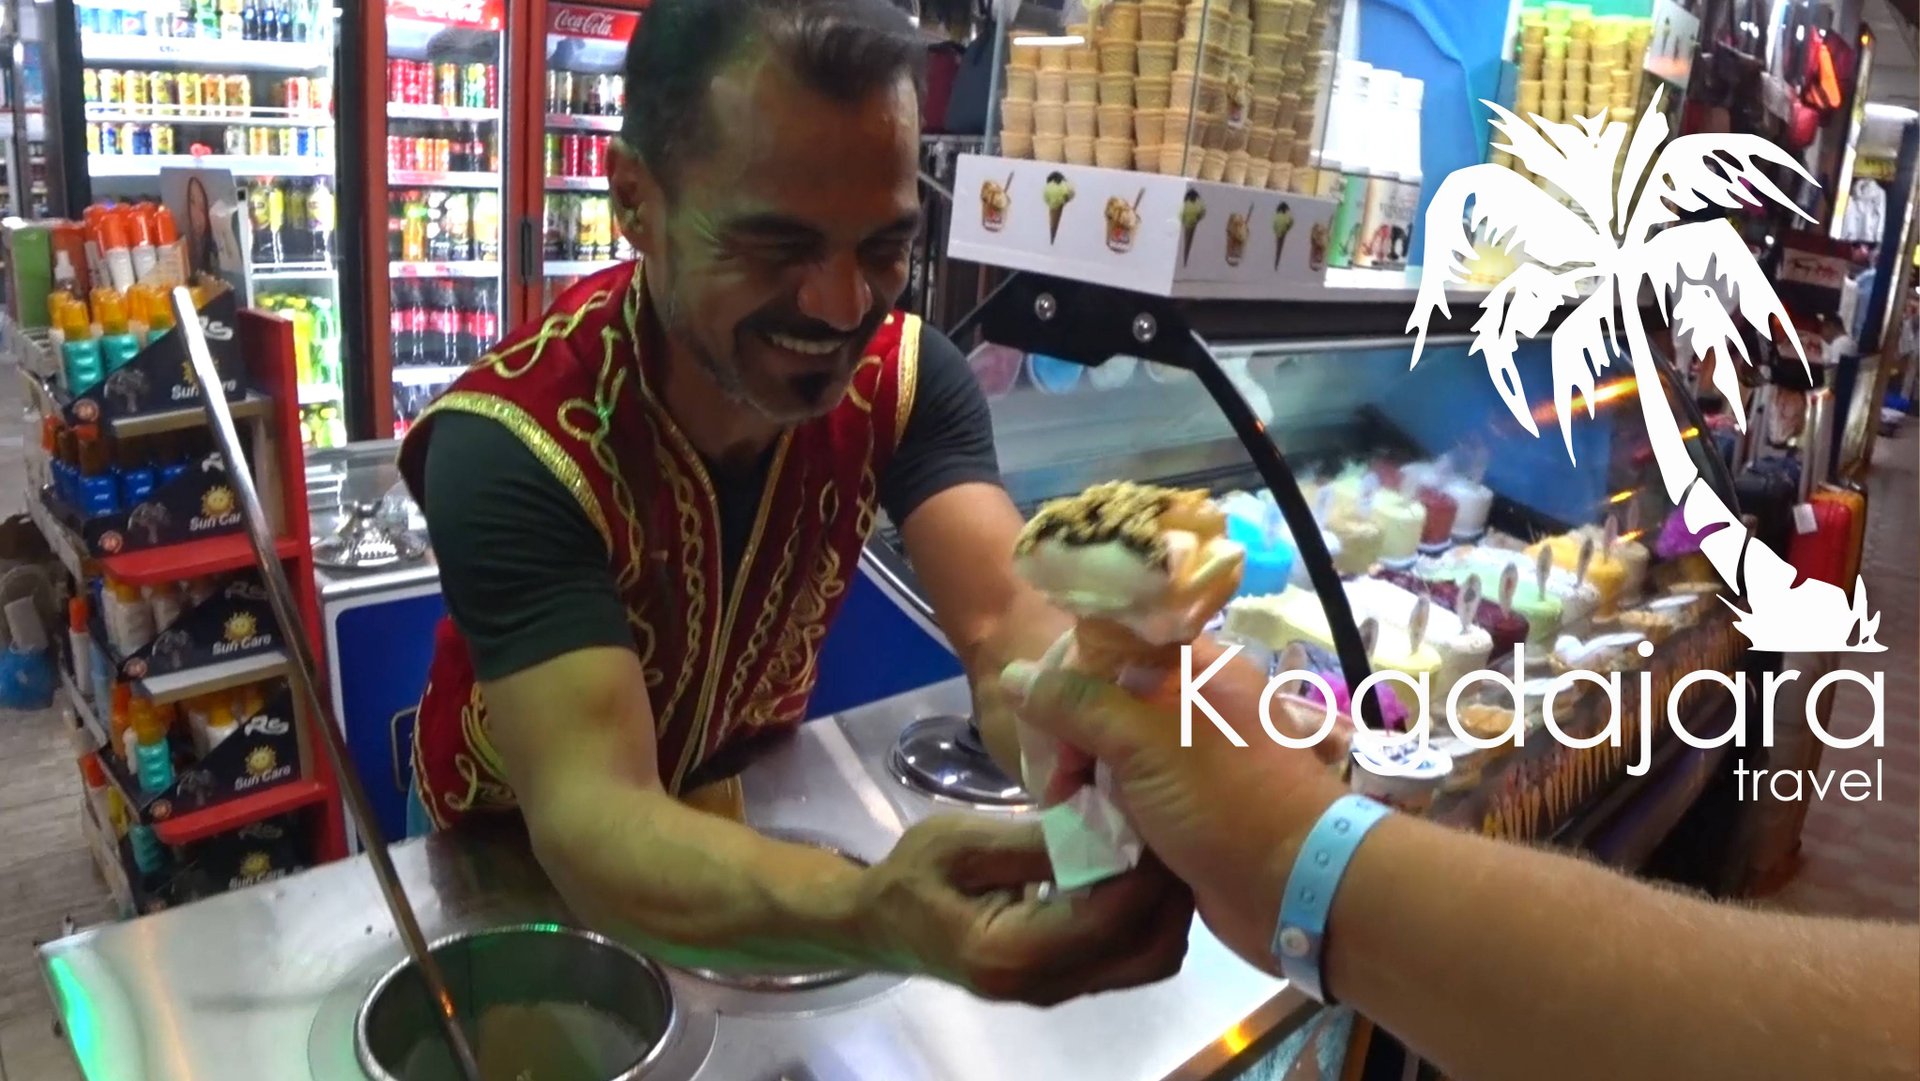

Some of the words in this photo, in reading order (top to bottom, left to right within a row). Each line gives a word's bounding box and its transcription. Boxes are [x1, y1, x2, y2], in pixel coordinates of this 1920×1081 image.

[171, 384, 201, 400] Sun
[189, 516, 217, 531] Sun
[211, 640, 240, 656] Sun
[240, 633, 273, 650] Care
[234, 776, 261, 792] Sun
[261, 765, 292, 782] Care
